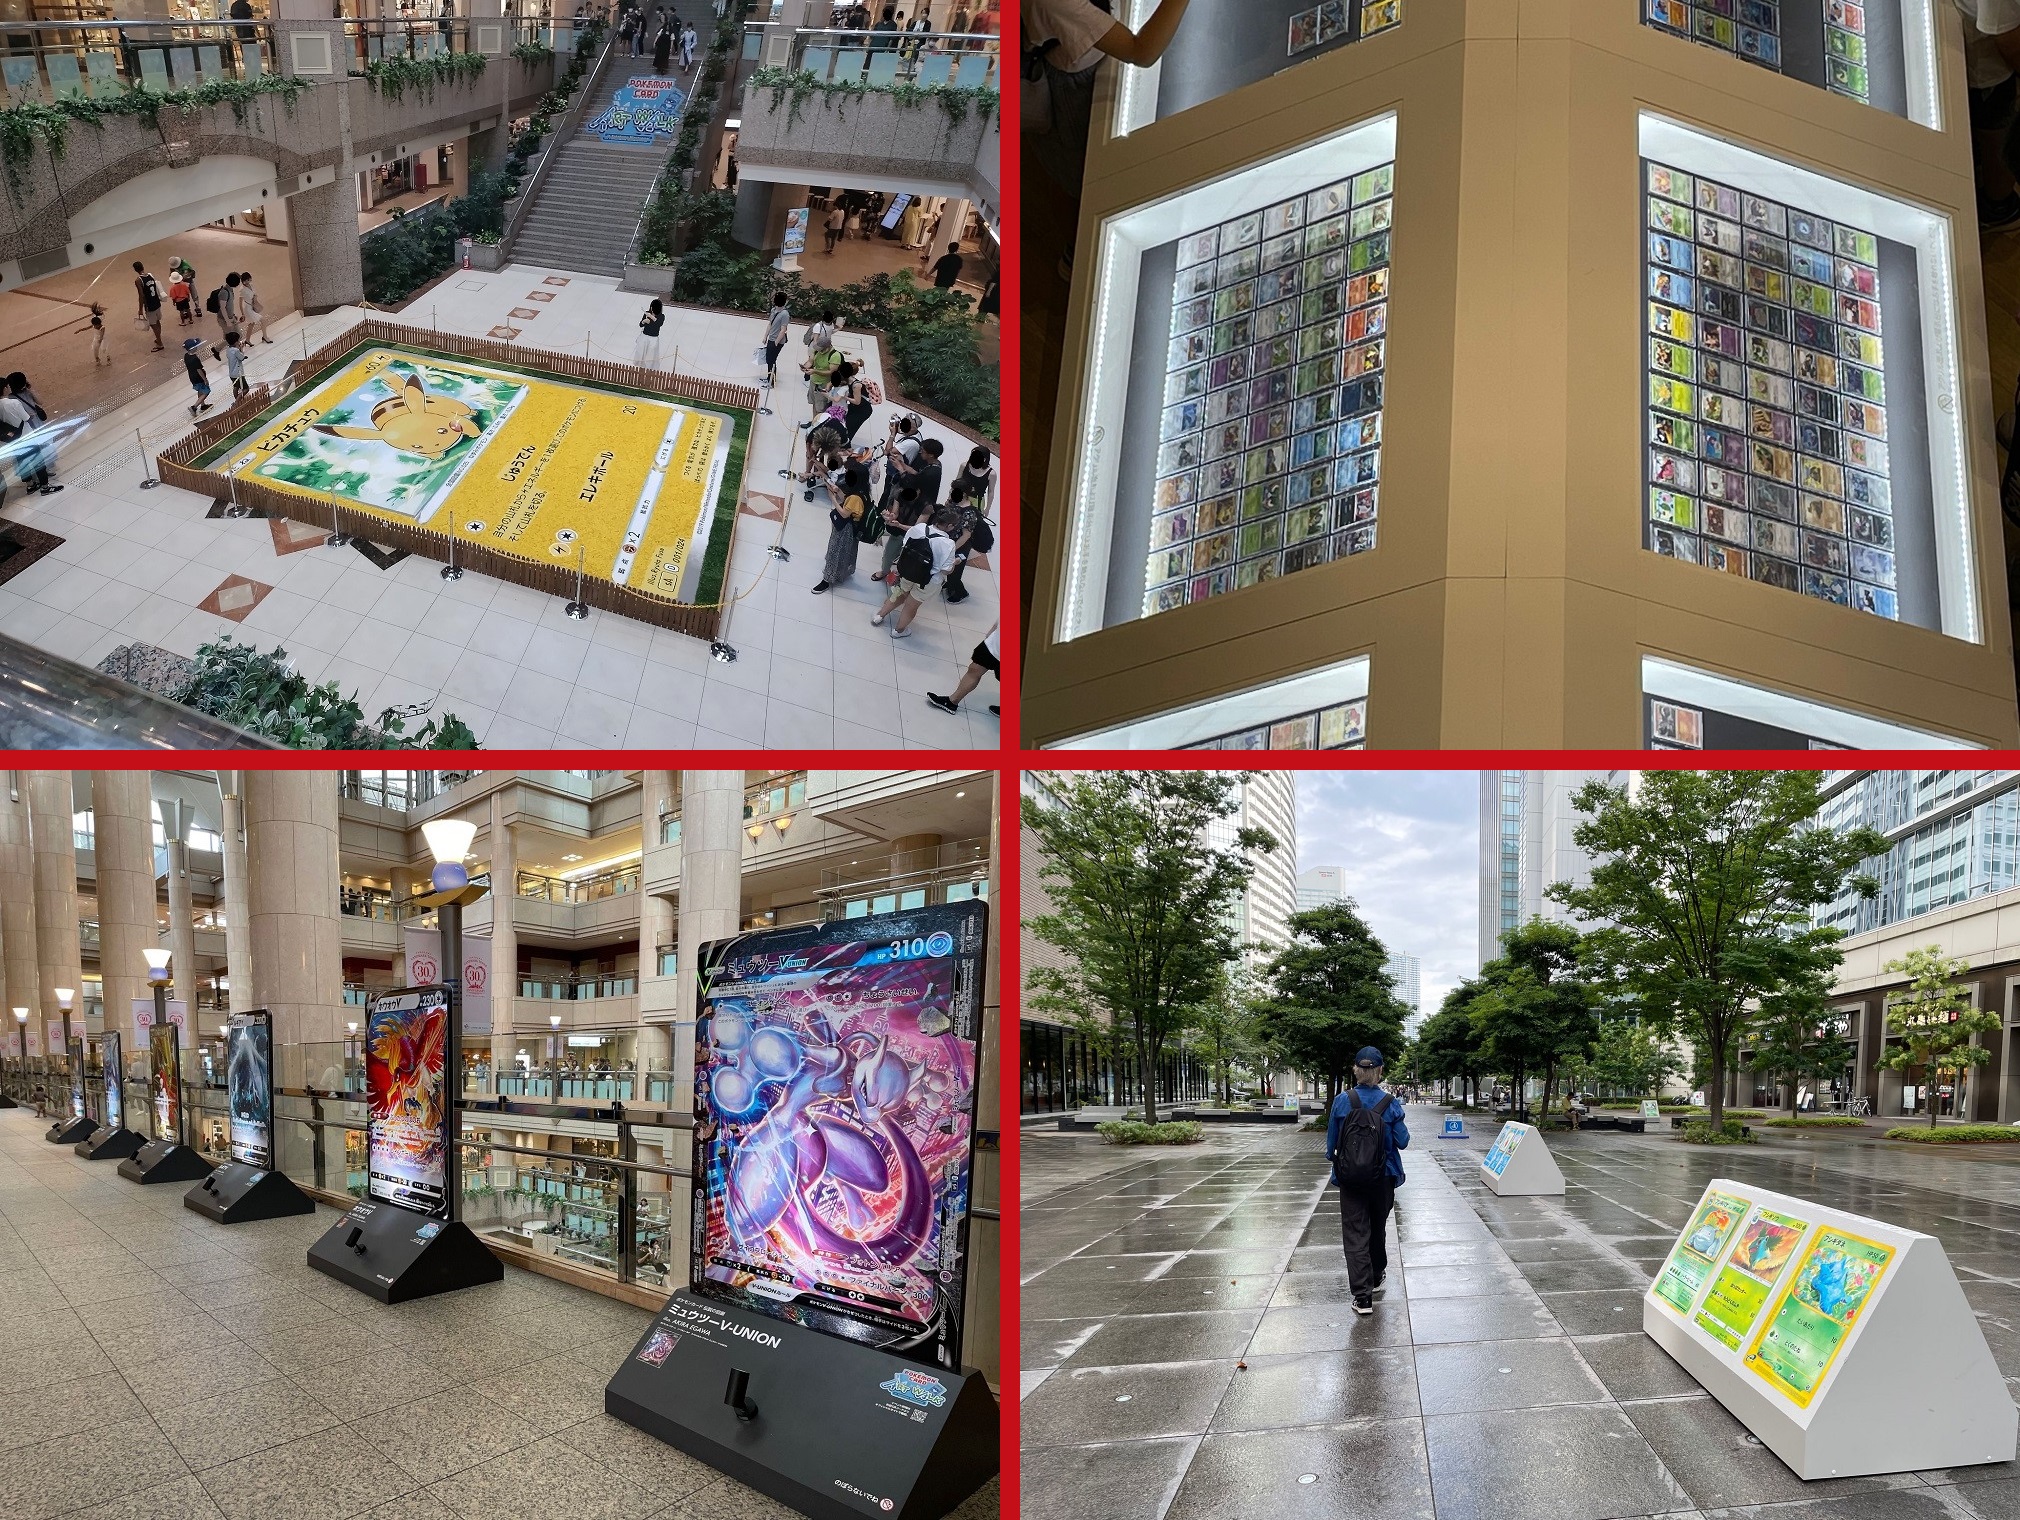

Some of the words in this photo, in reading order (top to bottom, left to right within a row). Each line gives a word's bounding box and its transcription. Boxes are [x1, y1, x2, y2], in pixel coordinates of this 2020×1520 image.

[633, 89, 659, 99] CARD
[633, 108, 679, 133] WALK
[622, 404, 638, 416] 20
[257, 406, 320, 452] ピカチュウ
[501, 445, 536, 483] じゅうでん
[579, 451, 614, 502] エレキボール
[673, 537, 685, 563] 001/024
[877, 952, 887, 960] HP
[889, 937, 924, 959] 310
[727, 957, 780, 975] ミュウツー
[422, 994, 434, 1006] 230
[862, 988, 918, 1000] ちょうさいせい
[1823, 1235, 1846, 1248] フシギダネ
[752, 1283, 792, 1299] V-UNIONルール
[850, 1276, 908, 1295] ファイナルバーン
[912, 1290, 928, 1302] 300
[668, 1303, 782, 1349] ミュウツーV-UNION
[672, 1318, 690, 1329] AKIRA
[689, 1323, 711, 1336] EGAWA
[834, 1479, 879, 1504] のぼらないでね
